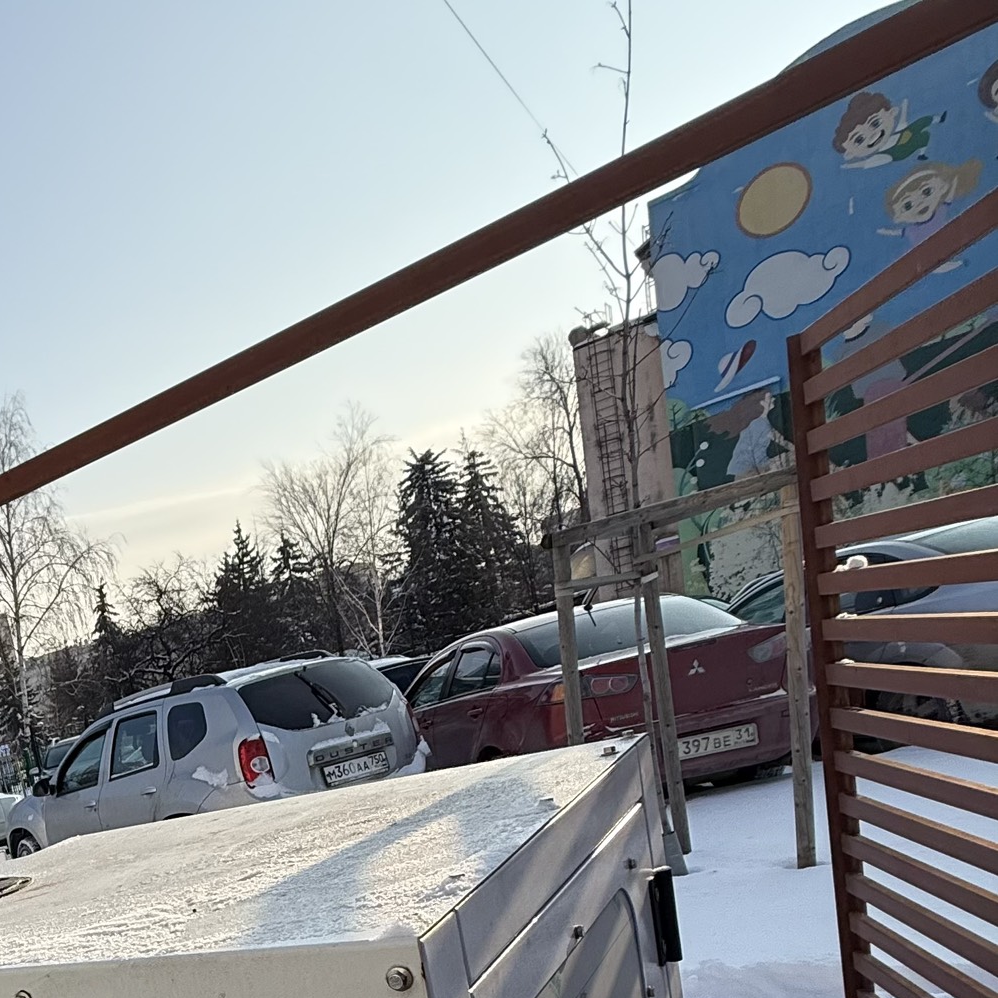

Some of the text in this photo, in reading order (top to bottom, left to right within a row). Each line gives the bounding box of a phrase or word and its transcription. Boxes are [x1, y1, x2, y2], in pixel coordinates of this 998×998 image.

[315, 737, 393, 761] DUSTER
[681, 735, 731, 755] 397ВЕ
[368, 753, 383, 766] 750
